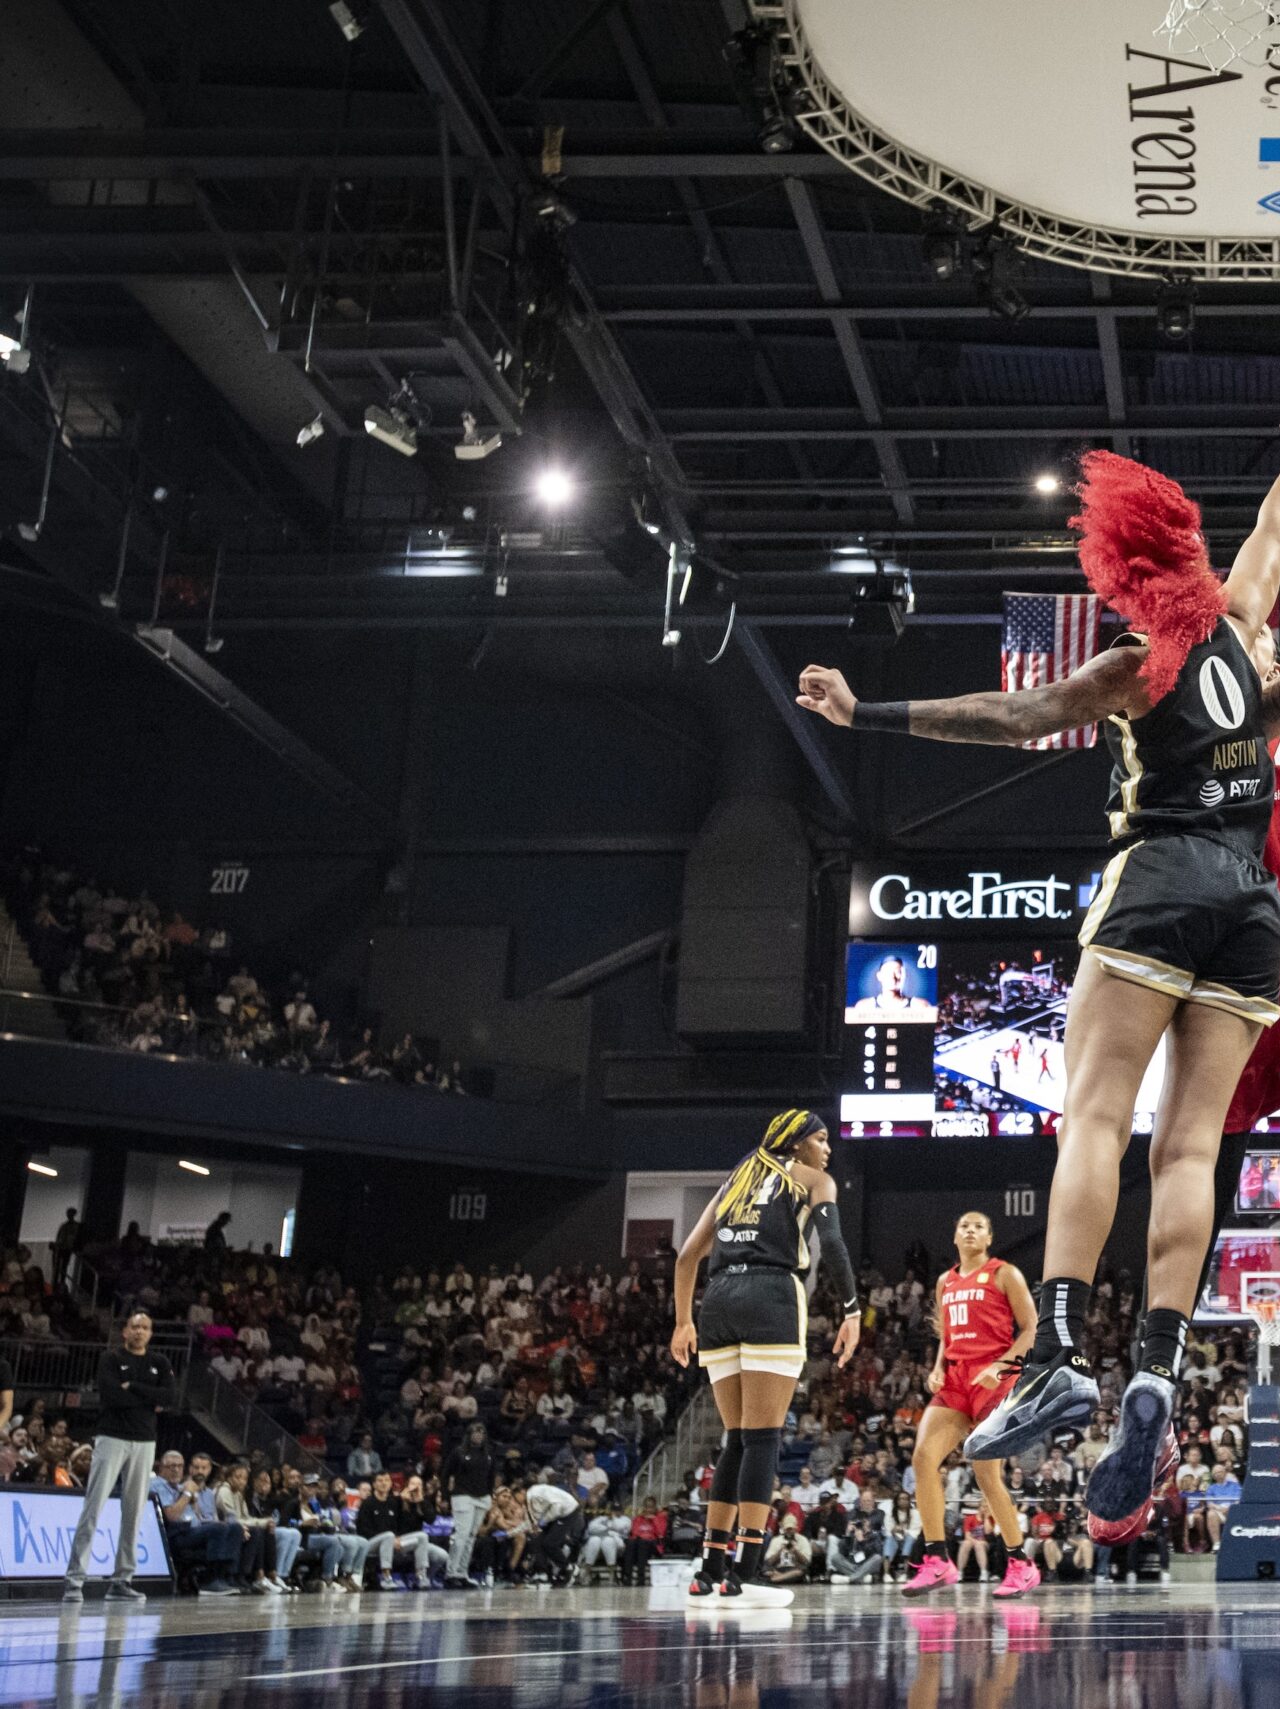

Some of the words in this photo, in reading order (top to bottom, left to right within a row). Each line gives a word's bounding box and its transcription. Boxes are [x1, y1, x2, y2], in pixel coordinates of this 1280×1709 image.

[1126, 44, 1243, 219] Arena
[1199, 655, 1246, 730] 0
[1212, 739, 1257, 771] AUSTIN
[1230, 778, 1261, 798] AT&T
[210, 869, 250, 893] 207
[917, 945, 938, 969] 20
[998, 1112, 1034, 1135] 42
[449, 1194, 487, 1220] 109
[1005, 1191, 1035, 1216] 110
[733, 1230, 759, 1242] AT&T
[942, 1288, 985, 1306] ATLANTA
